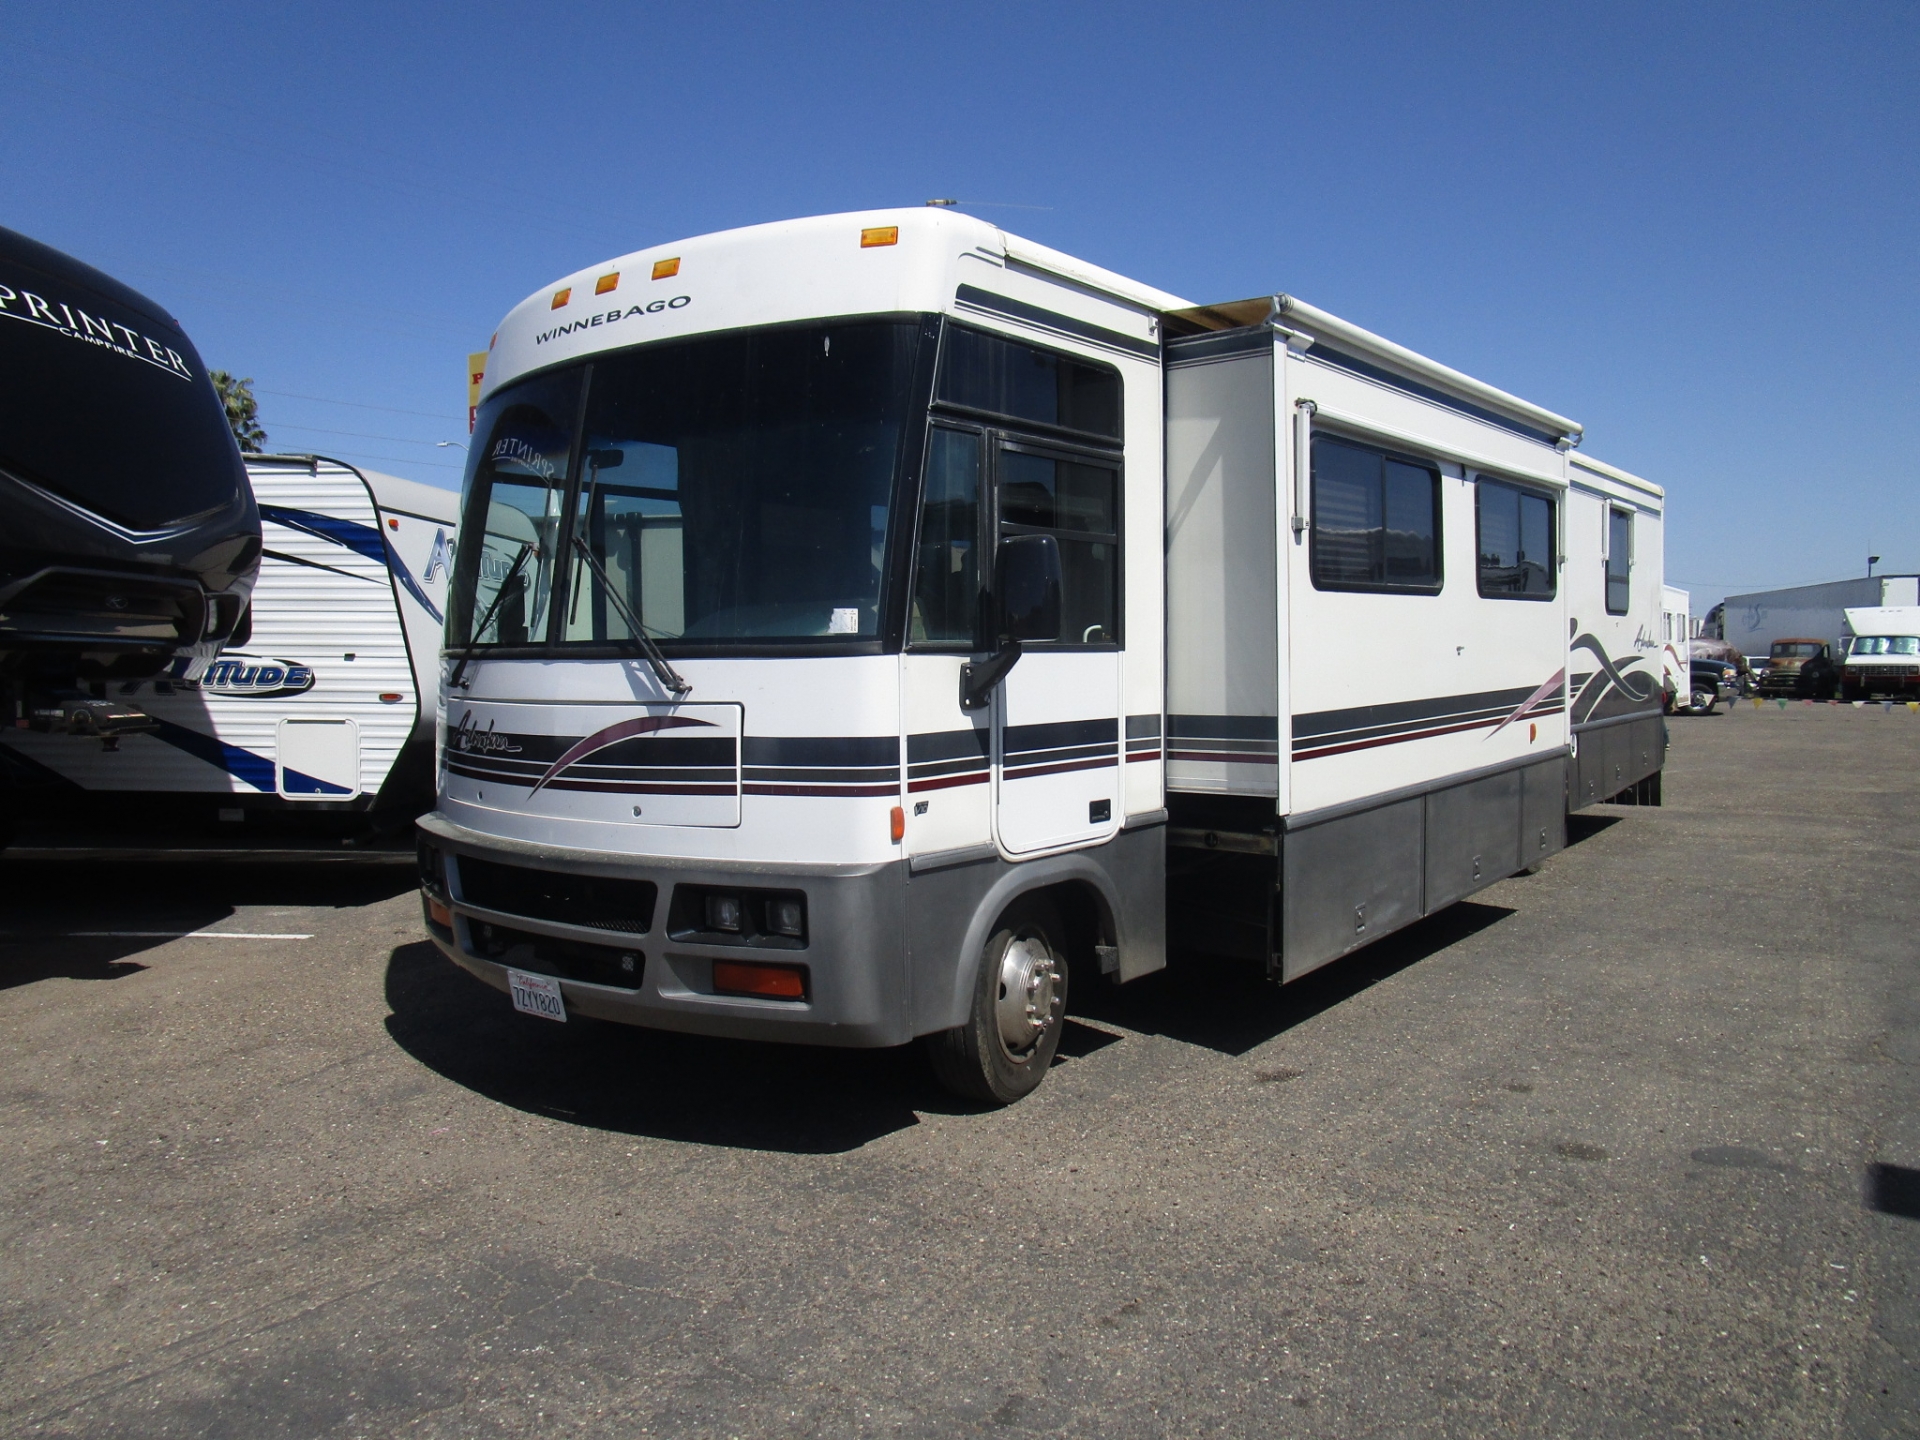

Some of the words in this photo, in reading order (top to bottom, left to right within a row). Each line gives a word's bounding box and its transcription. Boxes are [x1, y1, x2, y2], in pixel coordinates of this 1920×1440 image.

[536, 295, 692, 345] WINNEBAGO
[58, 327, 136, 359] CAMPFIRE
[513, 986, 561, 1015] 7ZYY820
